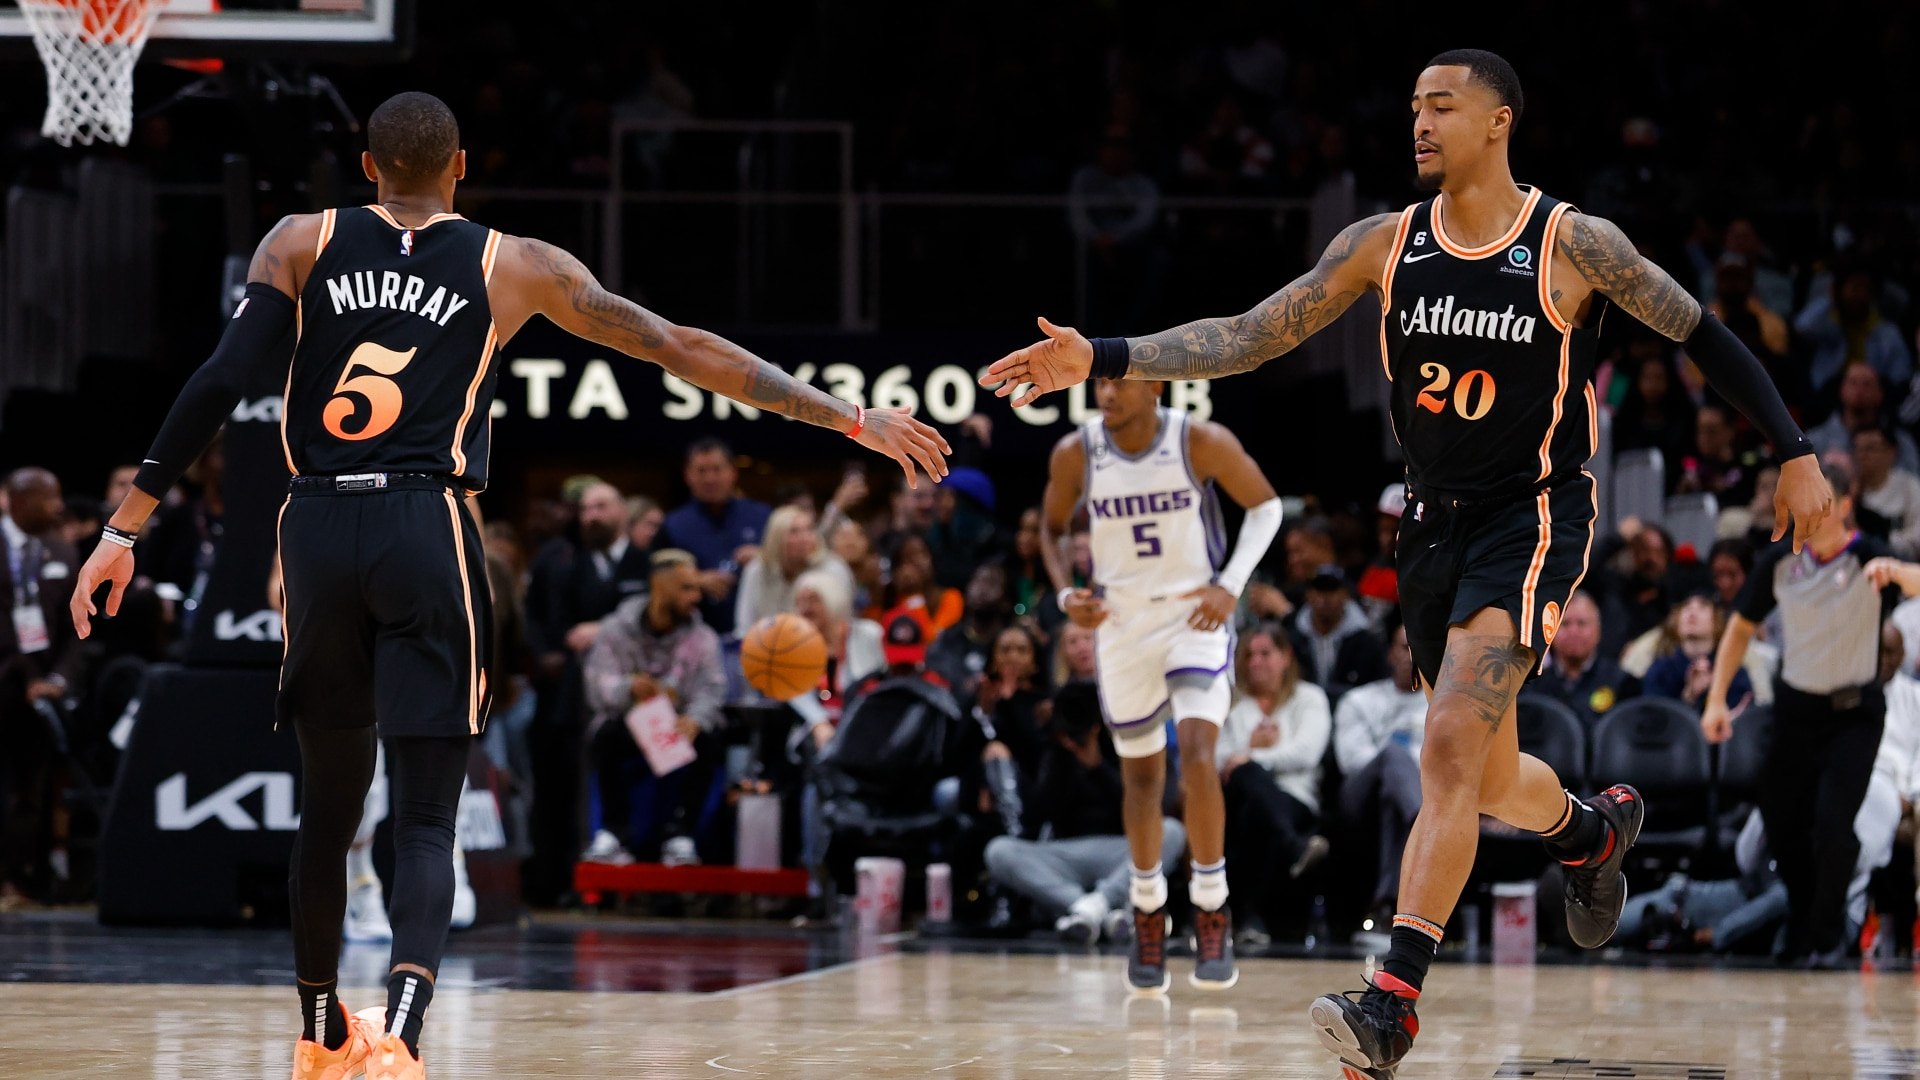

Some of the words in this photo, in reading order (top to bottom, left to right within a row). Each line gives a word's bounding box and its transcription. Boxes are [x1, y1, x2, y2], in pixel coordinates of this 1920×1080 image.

[1413, 231, 1427, 246] 6
[1499, 266, 1535, 277] sharecare
[326, 270, 470, 327] MURRAY
[1401, 295, 1537, 343] Atlanta
[322, 341, 418, 441] 5
[491, 358, 629, 420] TA
[1010, 379, 1213, 426] CLB
[1416, 362, 1496, 421] 20
[1092, 489, 1191, 518] KINGS
[1132, 522, 1162, 557] 5
